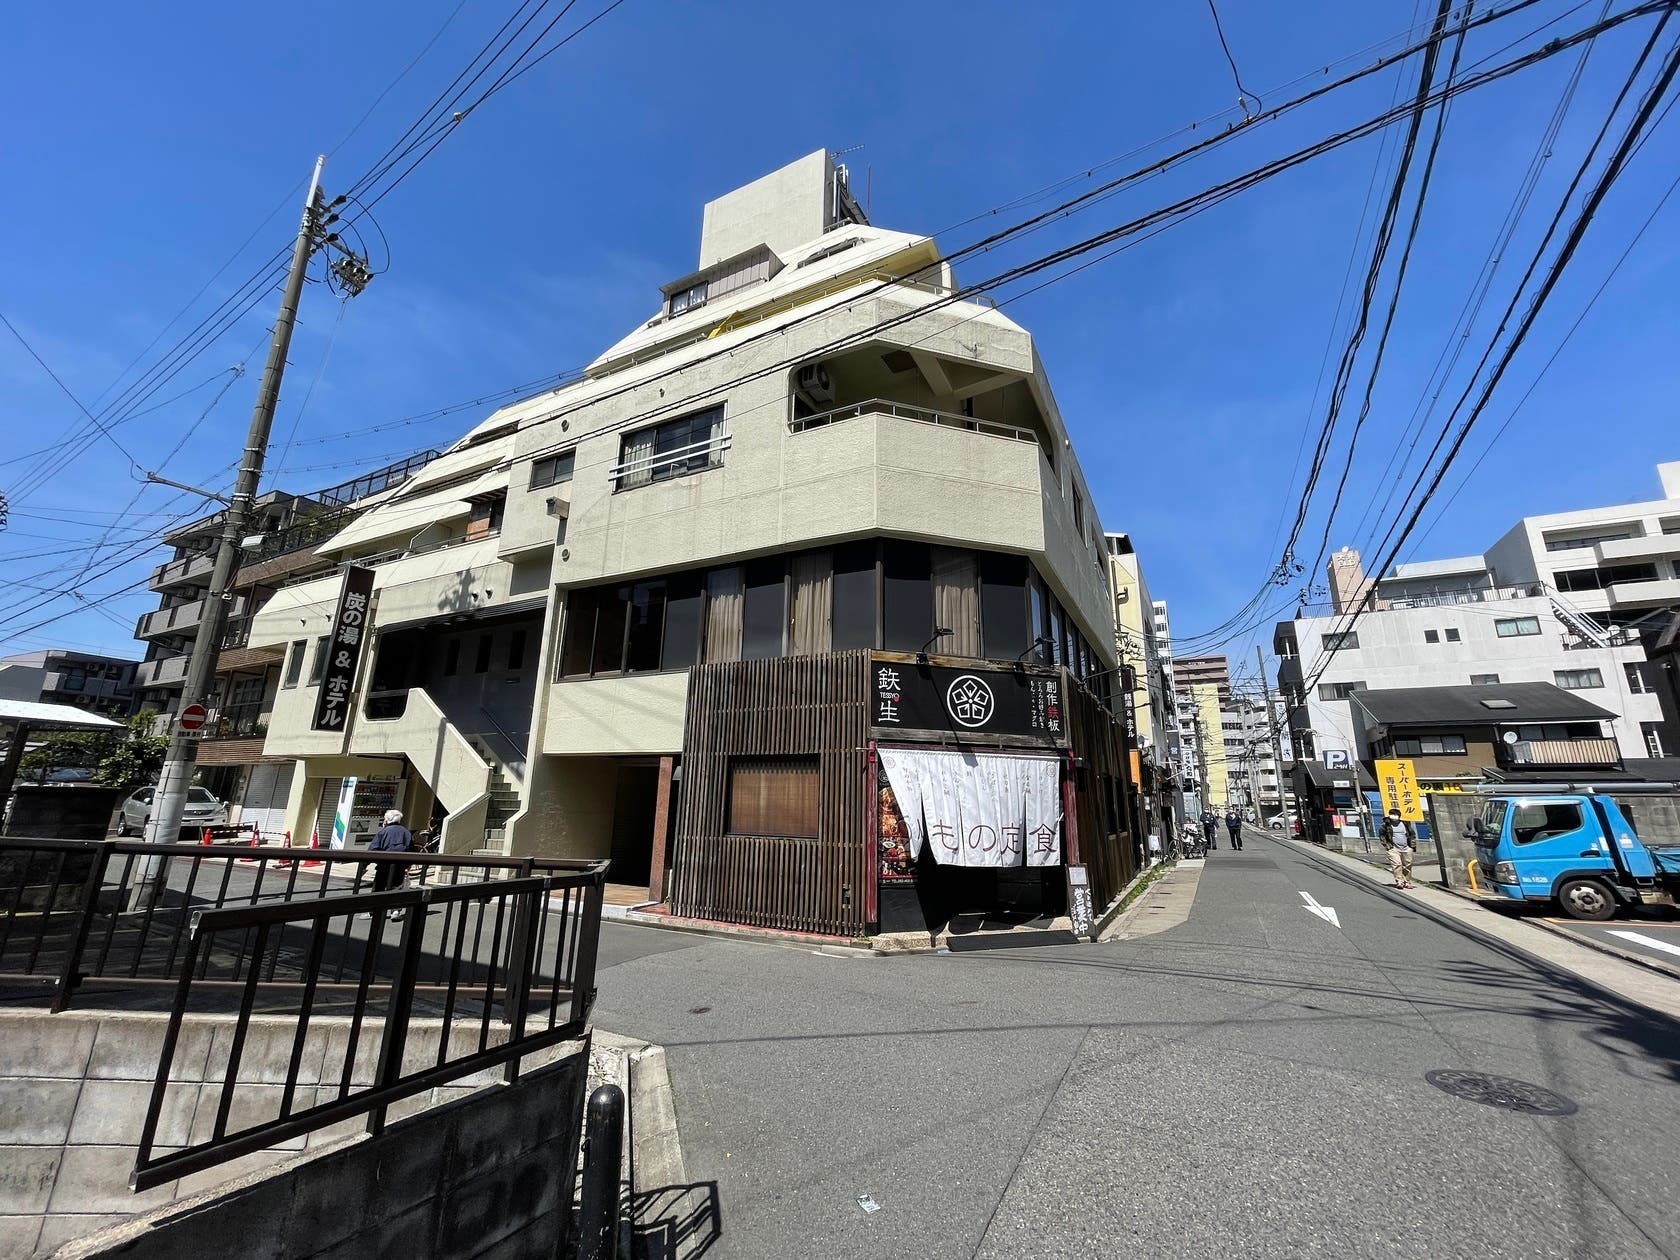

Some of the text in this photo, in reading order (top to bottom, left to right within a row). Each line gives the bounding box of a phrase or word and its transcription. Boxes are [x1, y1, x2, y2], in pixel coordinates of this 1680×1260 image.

[321, 592, 366, 726] 炭の湯 & ホテル
[1127, 719, 1135, 738] ホテル
[1326, 750, 1346, 769] P
[1386, 777, 1399, 808] 専用駐車
[1398, 762, 1416, 814] スーパーホテル
[1074, 887, 1089, 935] 営業中
